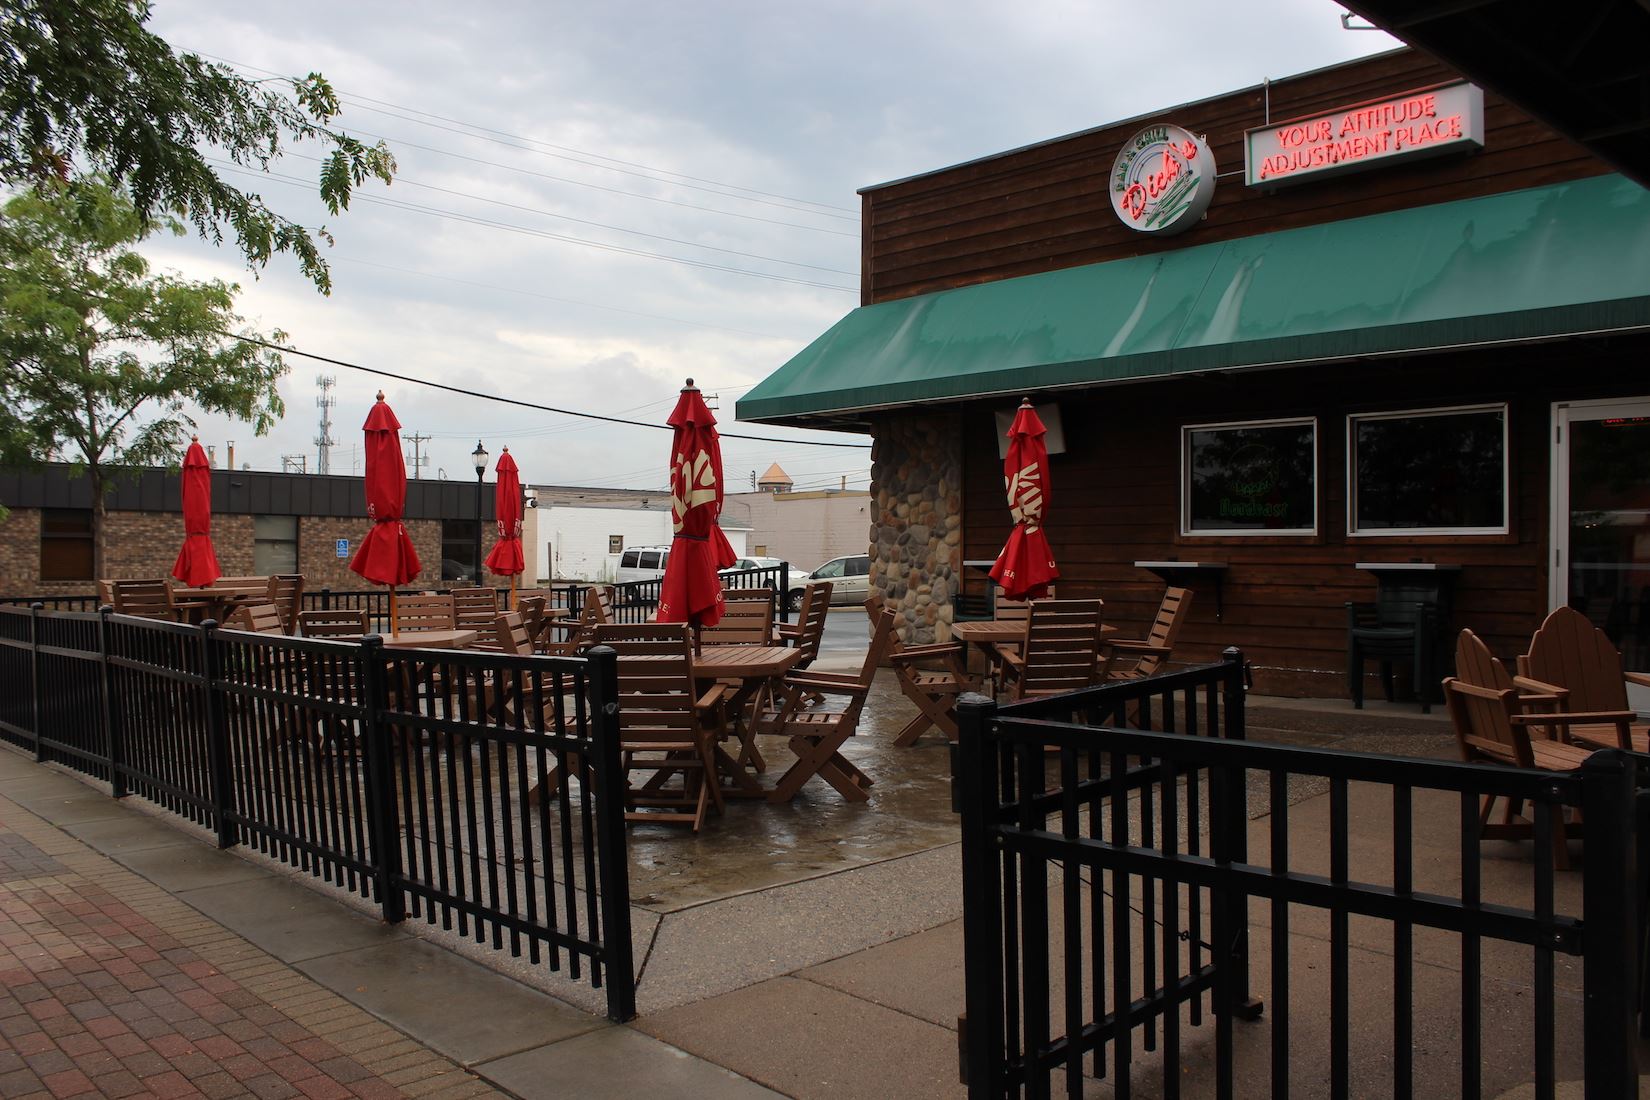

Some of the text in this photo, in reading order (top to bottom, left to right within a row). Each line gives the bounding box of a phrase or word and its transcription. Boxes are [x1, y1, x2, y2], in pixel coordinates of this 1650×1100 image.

[1135, 127, 1169, 150] GRILL
[1260, 114, 1462, 179] ADJUSTMENT PLACE
[1276, 94, 1436, 148] YOUR ATTITUDE
[1121, 140, 1198, 220] Dick's
